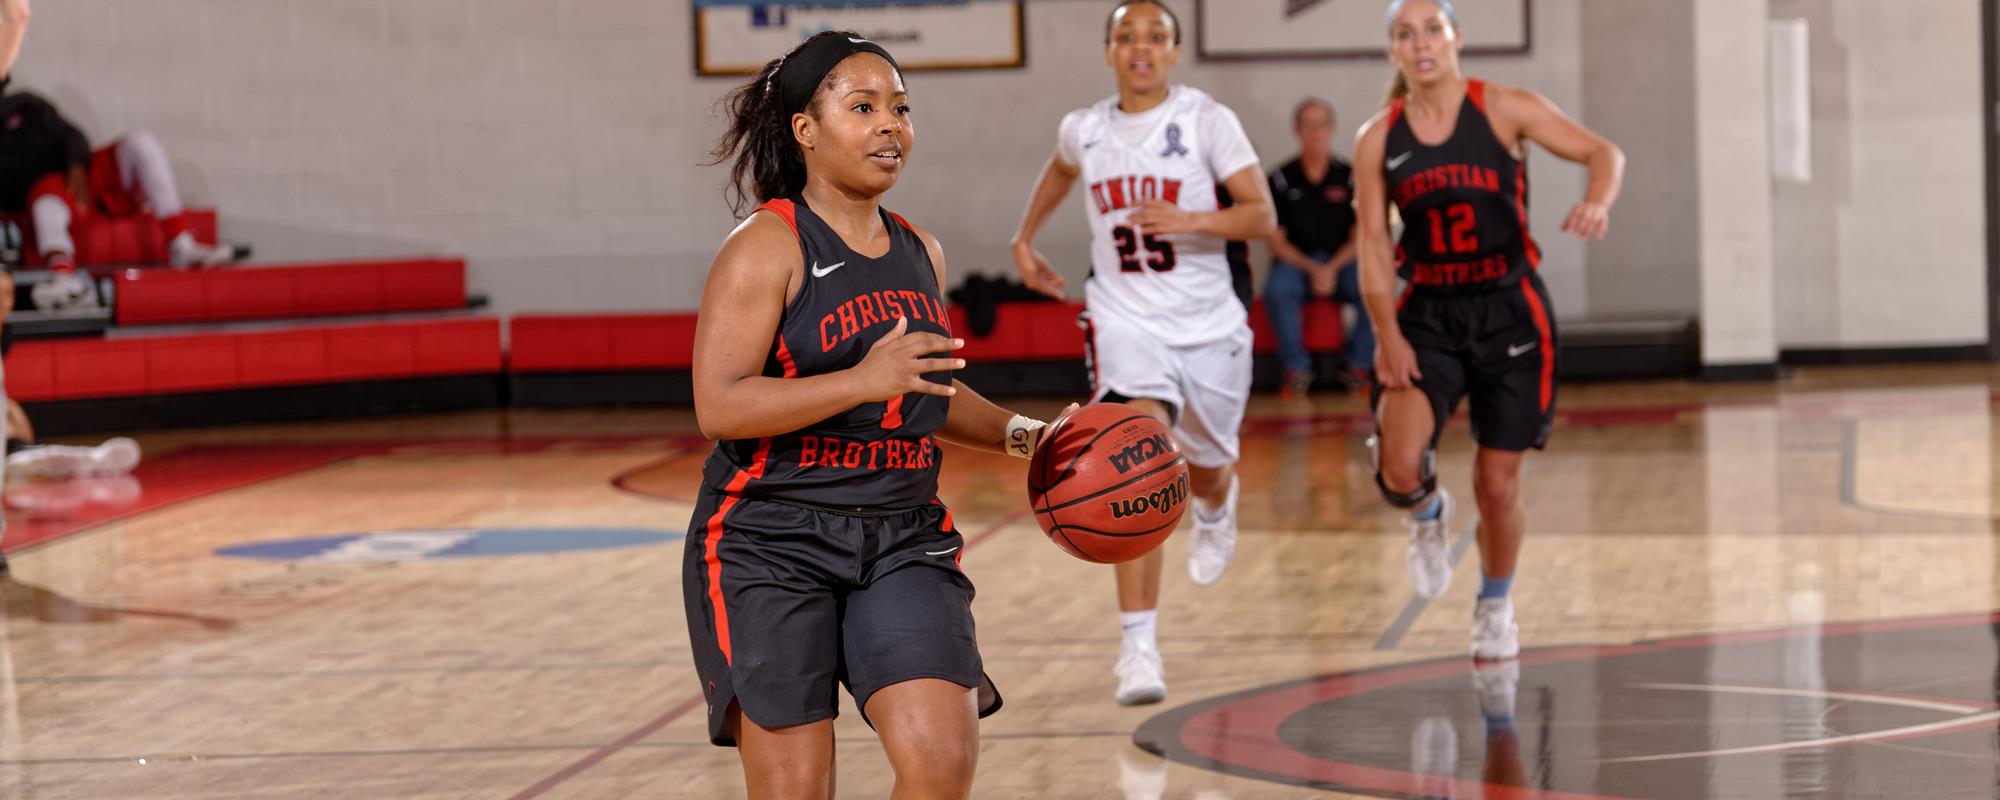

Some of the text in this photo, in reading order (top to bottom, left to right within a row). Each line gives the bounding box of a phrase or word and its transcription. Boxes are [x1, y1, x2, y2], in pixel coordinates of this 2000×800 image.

[1091, 175, 1182, 214] UNION
[1112, 225, 1177, 273] 25
[1427, 203, 1478, 254] 12
[819, 289, 949, 353] CHRISTIA
[1010, 427, 1029, 455] GP
[1109, 432, 1174, 475] NCAA
[1110, 471, 1190, 519] Wilson
